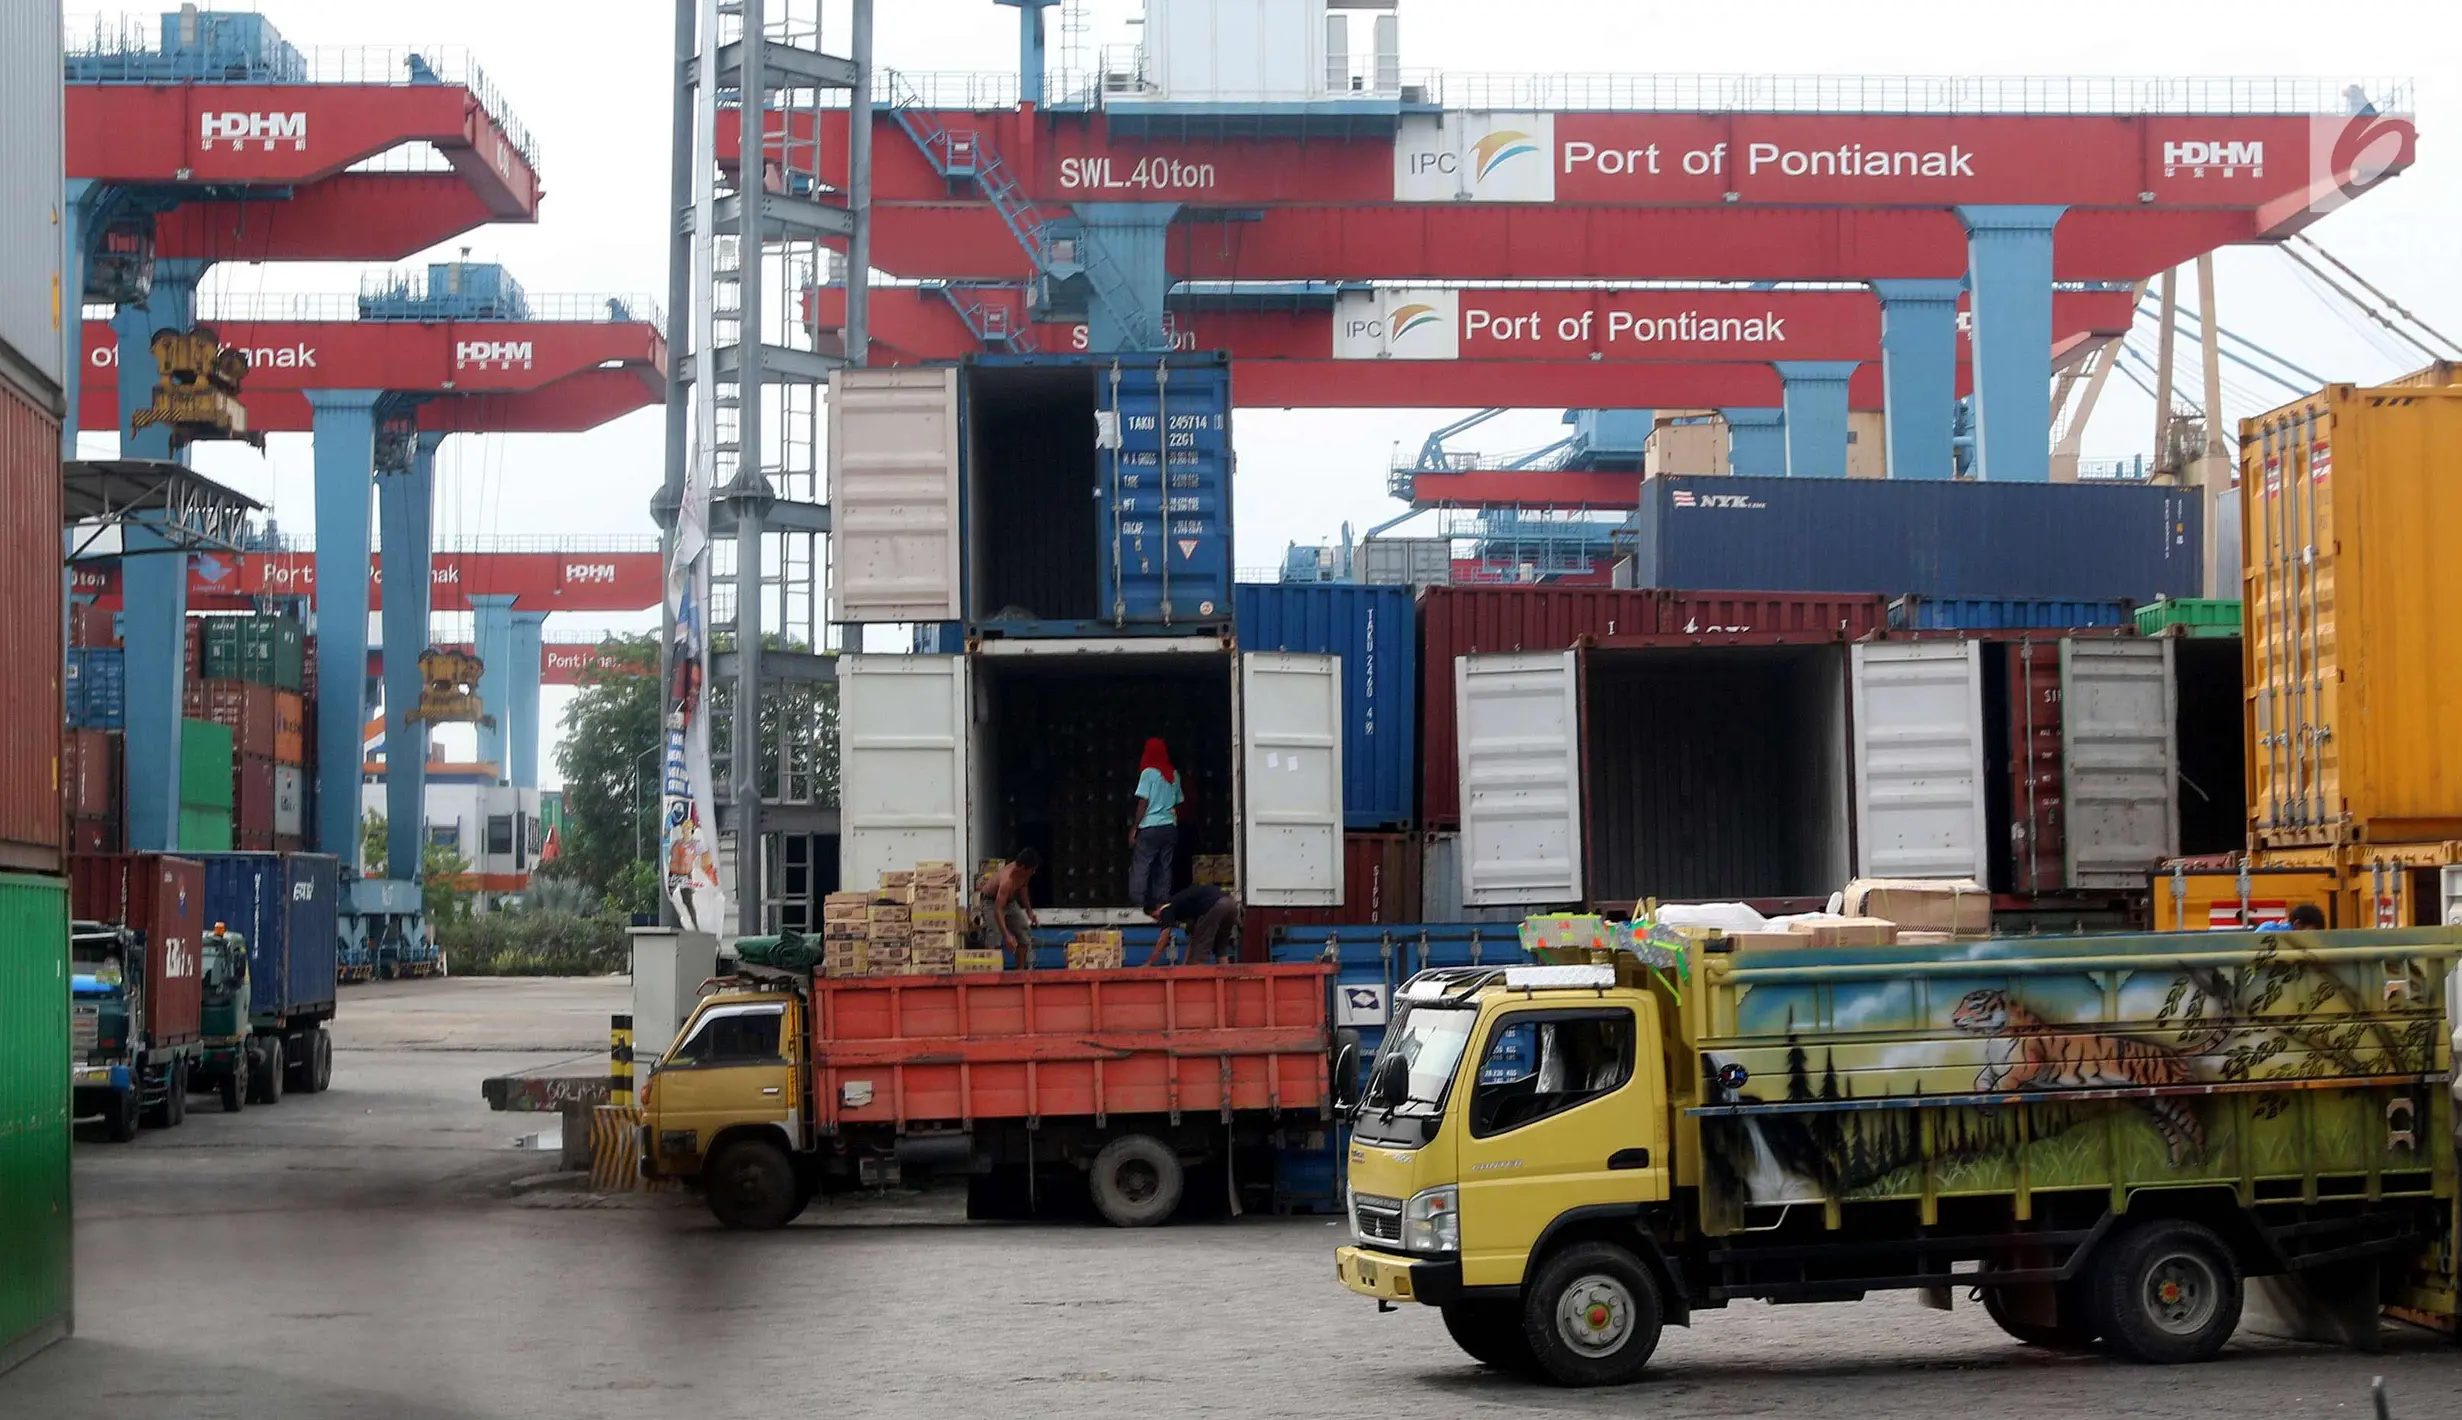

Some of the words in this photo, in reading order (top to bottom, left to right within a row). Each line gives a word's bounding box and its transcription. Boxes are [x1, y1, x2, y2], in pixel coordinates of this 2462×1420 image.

[201, 111, 306, 137] HDHM
[1410, 152, 1457, 174] IPC
[1564, 141, 1660, 175] Port
[1682, 142, 1727, 175] of
[1748, 143, 1975, 177] Pontianak
[2163, 141, 2263, 164] HDHM
[1060, 157, 1215, 189] SWL.40ton
[1346, 320, 1383, 339] IPC
[1465, 310, 1541, 341] Port
[1558, 310, 1594, 341] of
[1608, 310, 1786, 341] Pontianak
[456, 341, 532, 360] HDHM
[1128, 416, 1156, 430] TAKU
[1169, 415, 1208, 430] 245714
[1700, 494, 1749, 508] NYK
[263, 563, 314, 588] Port
[565, 563, 616, 578] HDHM
